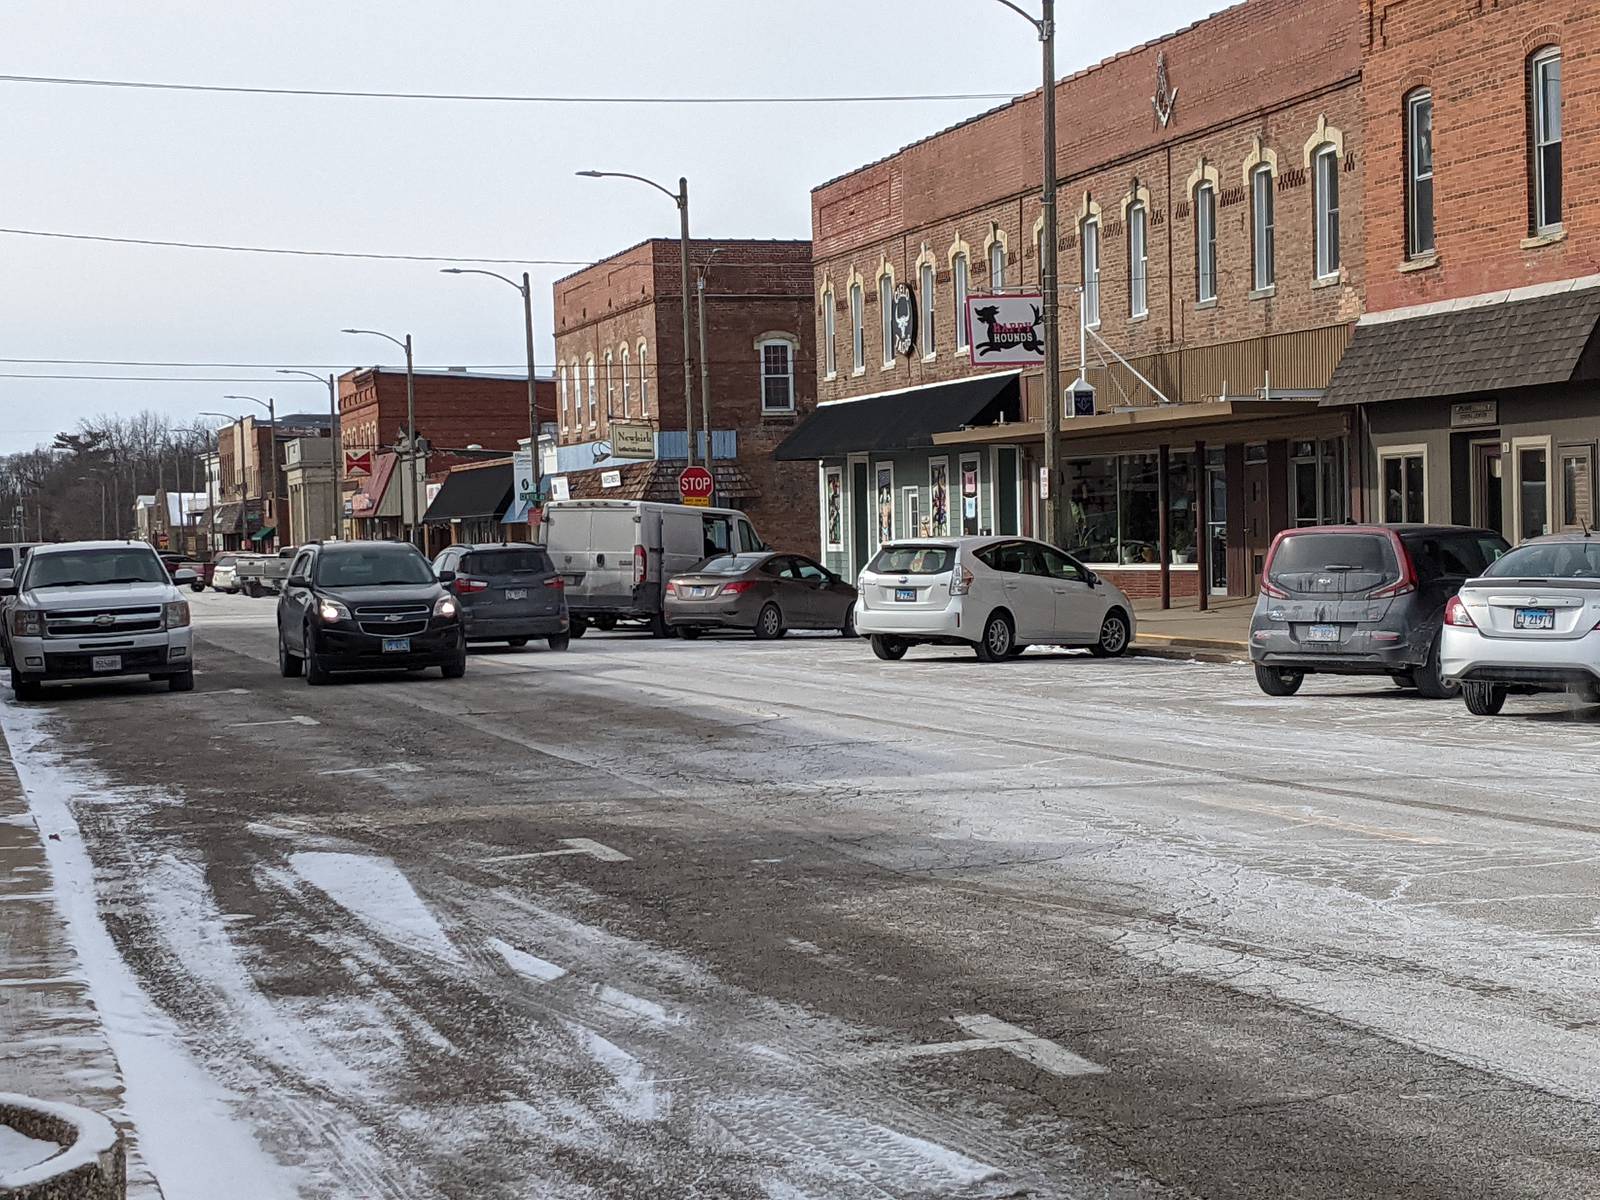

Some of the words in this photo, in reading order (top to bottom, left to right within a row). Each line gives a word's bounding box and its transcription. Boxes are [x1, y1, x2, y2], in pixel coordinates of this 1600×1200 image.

[993, 322, 1032, 332] HAPPY
[994, 333, 1032, 342] HOUNDS
[681, 477, 710, 490] STOP
